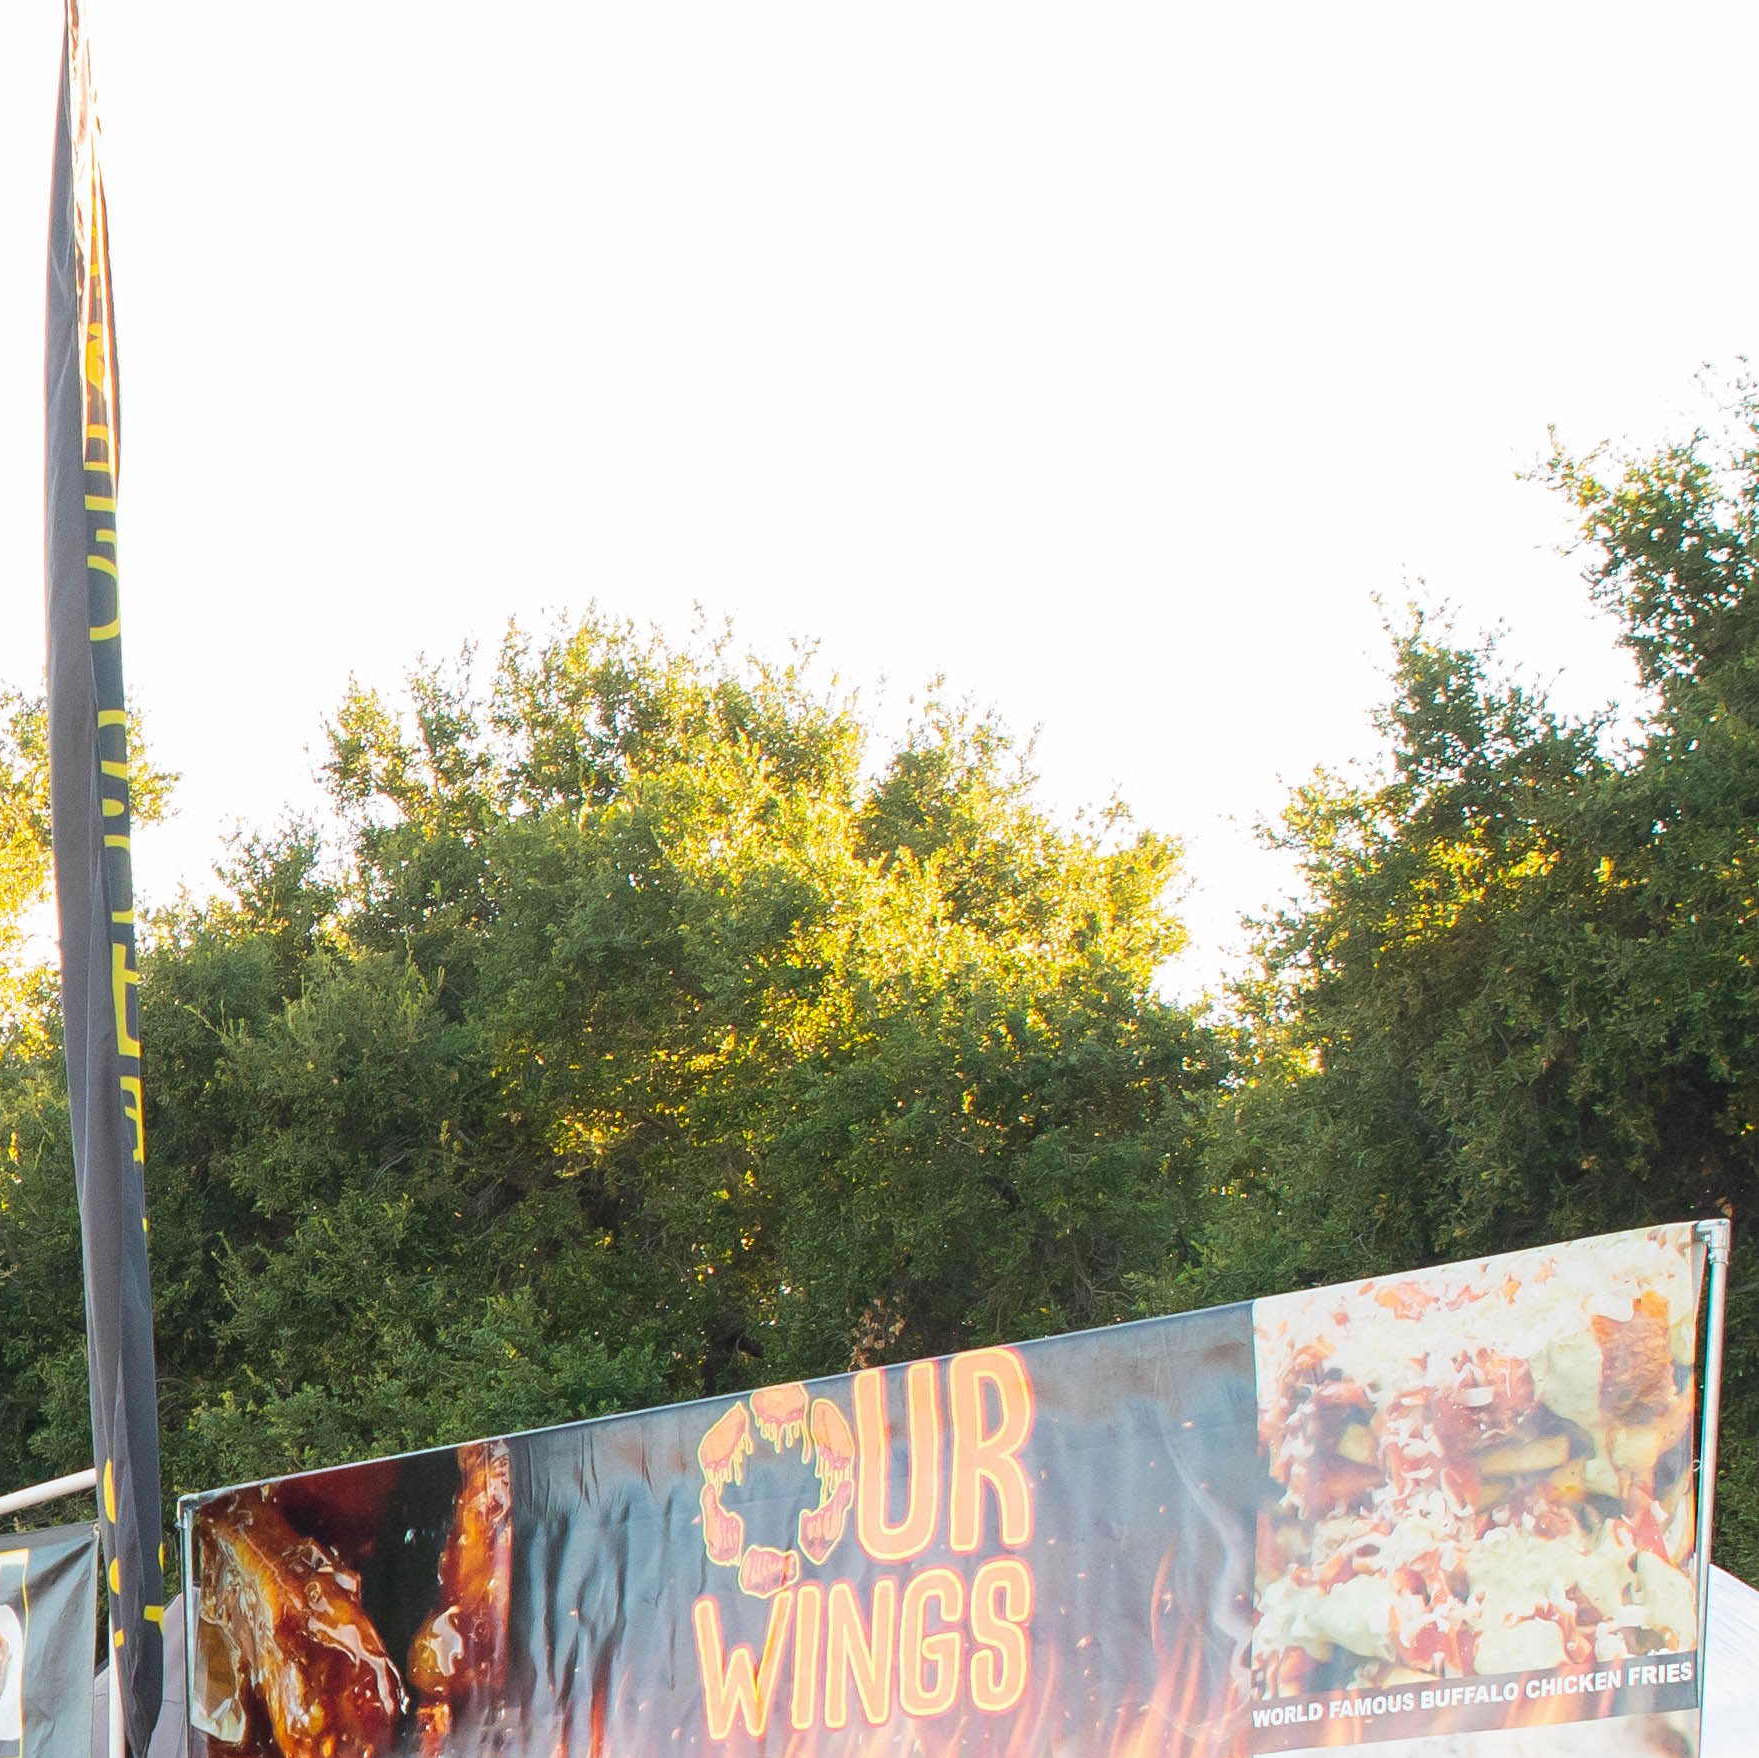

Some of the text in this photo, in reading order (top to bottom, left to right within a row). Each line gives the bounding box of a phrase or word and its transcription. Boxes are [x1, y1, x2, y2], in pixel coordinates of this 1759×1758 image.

[692, 1558, 1032, 1741] WINGS
[1252, 1661, 1693, 1729] WORLD FAMOUS BUFFALO CHICKEN FRIES
